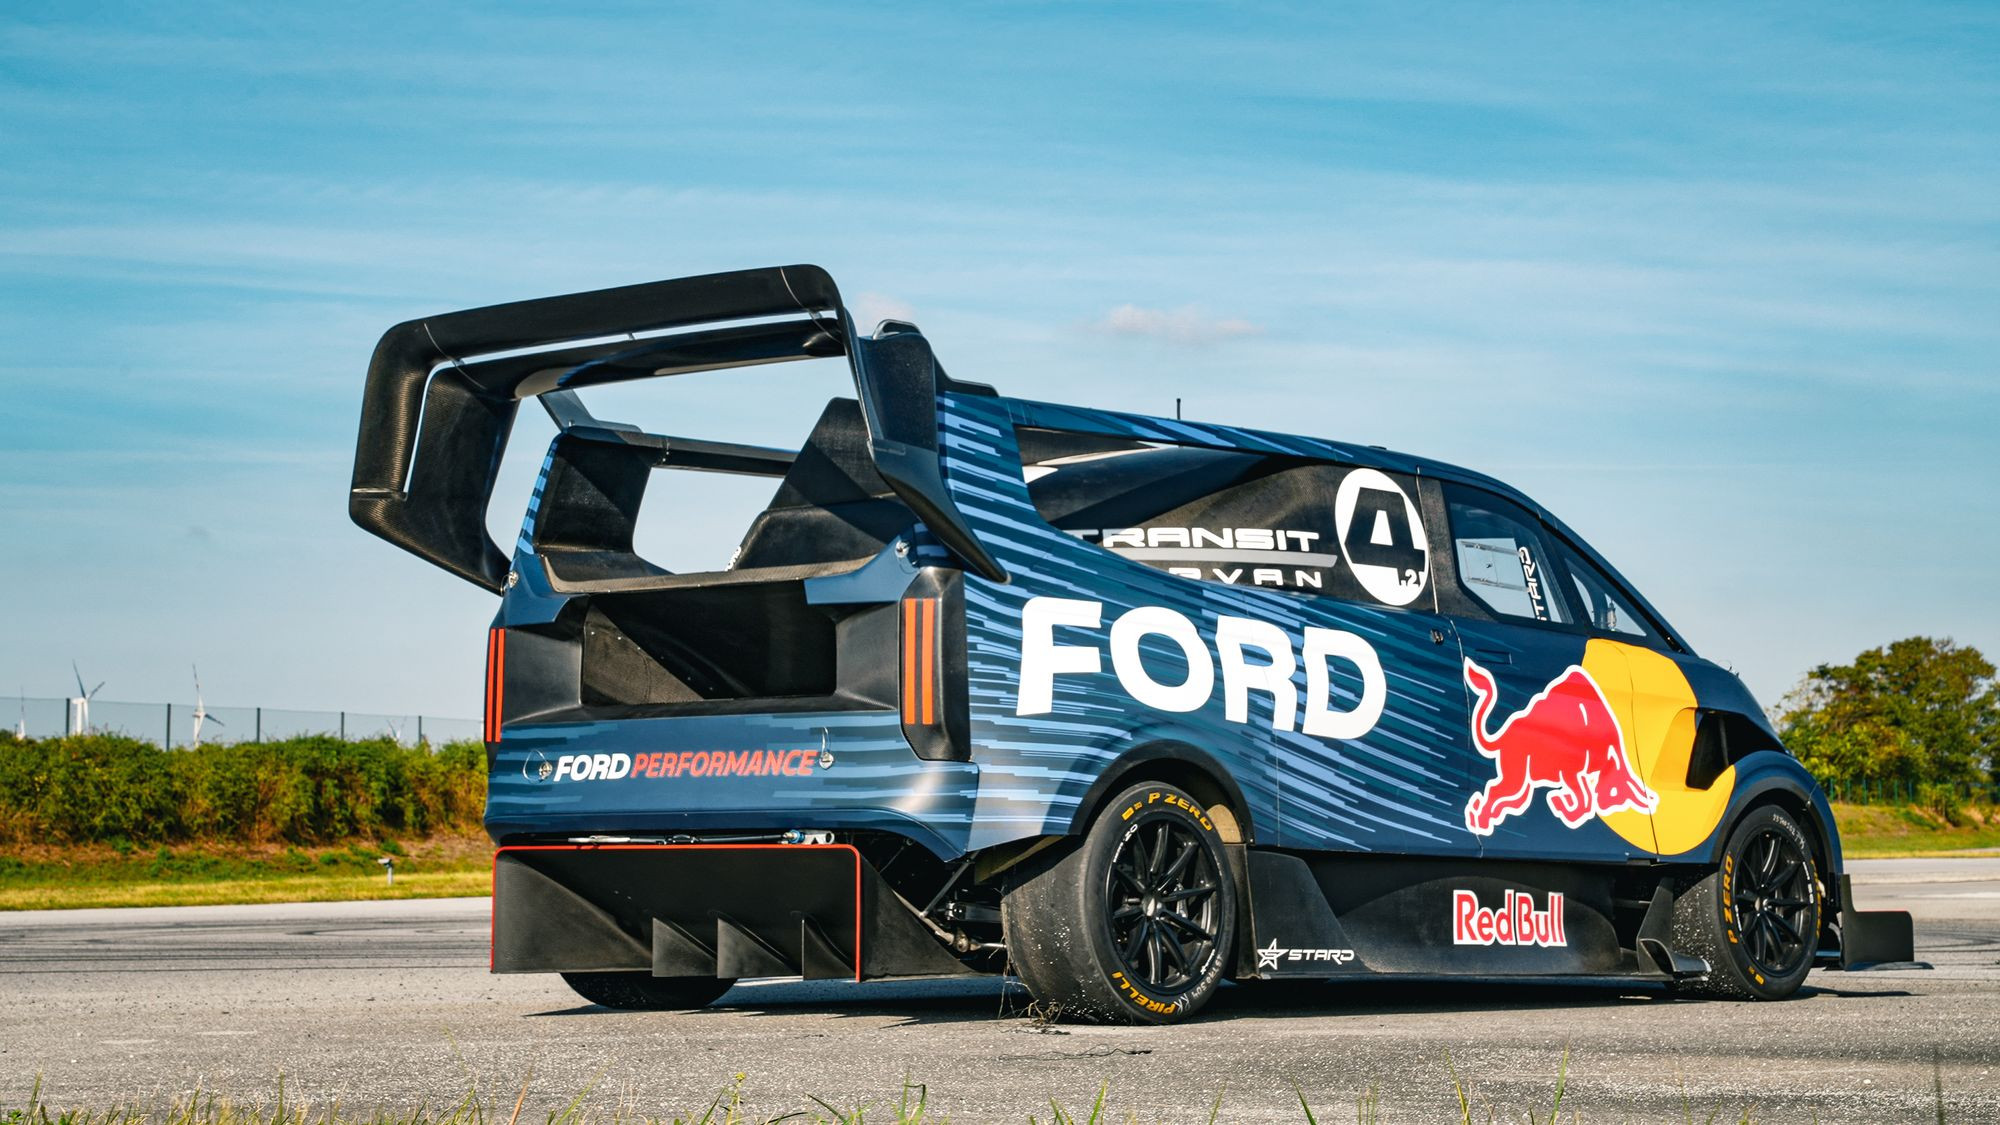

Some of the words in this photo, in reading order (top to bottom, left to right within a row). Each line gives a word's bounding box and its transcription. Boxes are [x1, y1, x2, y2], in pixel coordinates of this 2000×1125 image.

[1518, 546, 1548, 621] TARD
[1016, 596, 1387, 740] FORD
[553, 753, 631, 782] FORD
[630, 749, 818, 779] PERFORMANCE
[1164, 793, 1213, 831] ZERO
[1287, 949, 1355, 965] STARD
[1111, 971, 1176, 1014] PIRELLI
